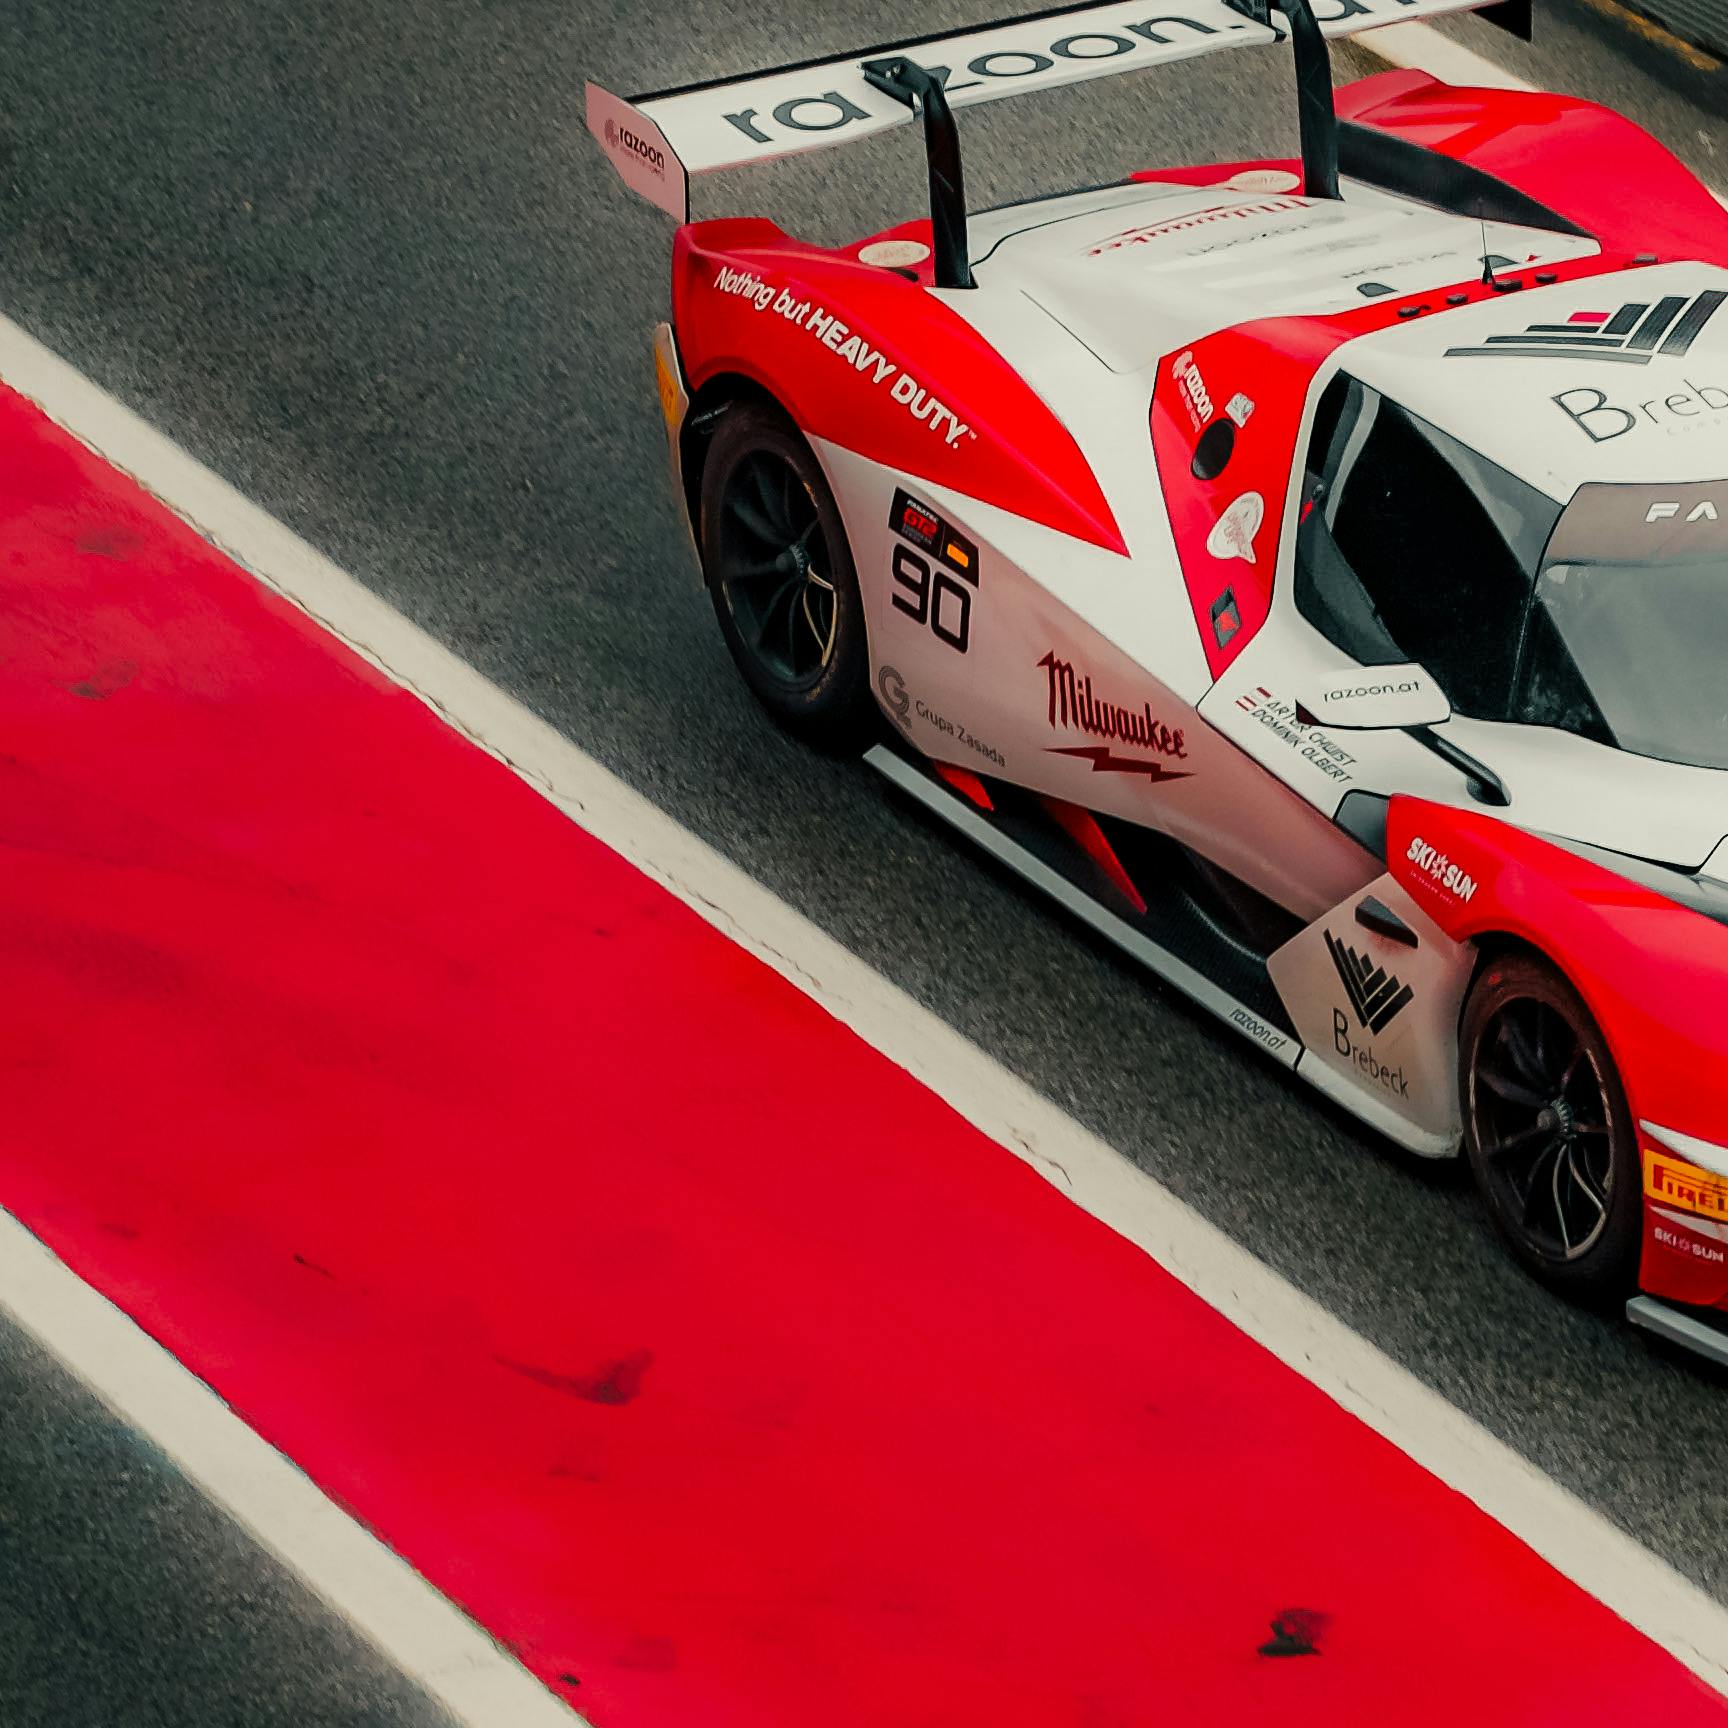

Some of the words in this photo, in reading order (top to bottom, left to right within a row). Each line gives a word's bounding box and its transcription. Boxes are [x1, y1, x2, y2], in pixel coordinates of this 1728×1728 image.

[620, 127, 665, 170] razoon
[713, 266, 776, 311] Nothing
[773, 288, 811, 325] but
[805, 308, 897, 384] HEAVY
[1184, 363, 1214, 424] razoon
[891, 542, 972, 655] 90
[1036, 649, 1189, 760] Milwaukee
[1323, 681, 1420, 703] razoon.at
[956, 726, 1007, 768] Zasada
[1406, 837, 1437, 871] SKI
[1442, 864, 1478, 904] SUN
[1230, 1008, 1288, 1051] razoon.at
[1333, 1007, 1409, 1101] Brebeck
[1654, 1226, 1678, 1246] SKI
[1692, 1243, 1724, 1263] SUN
